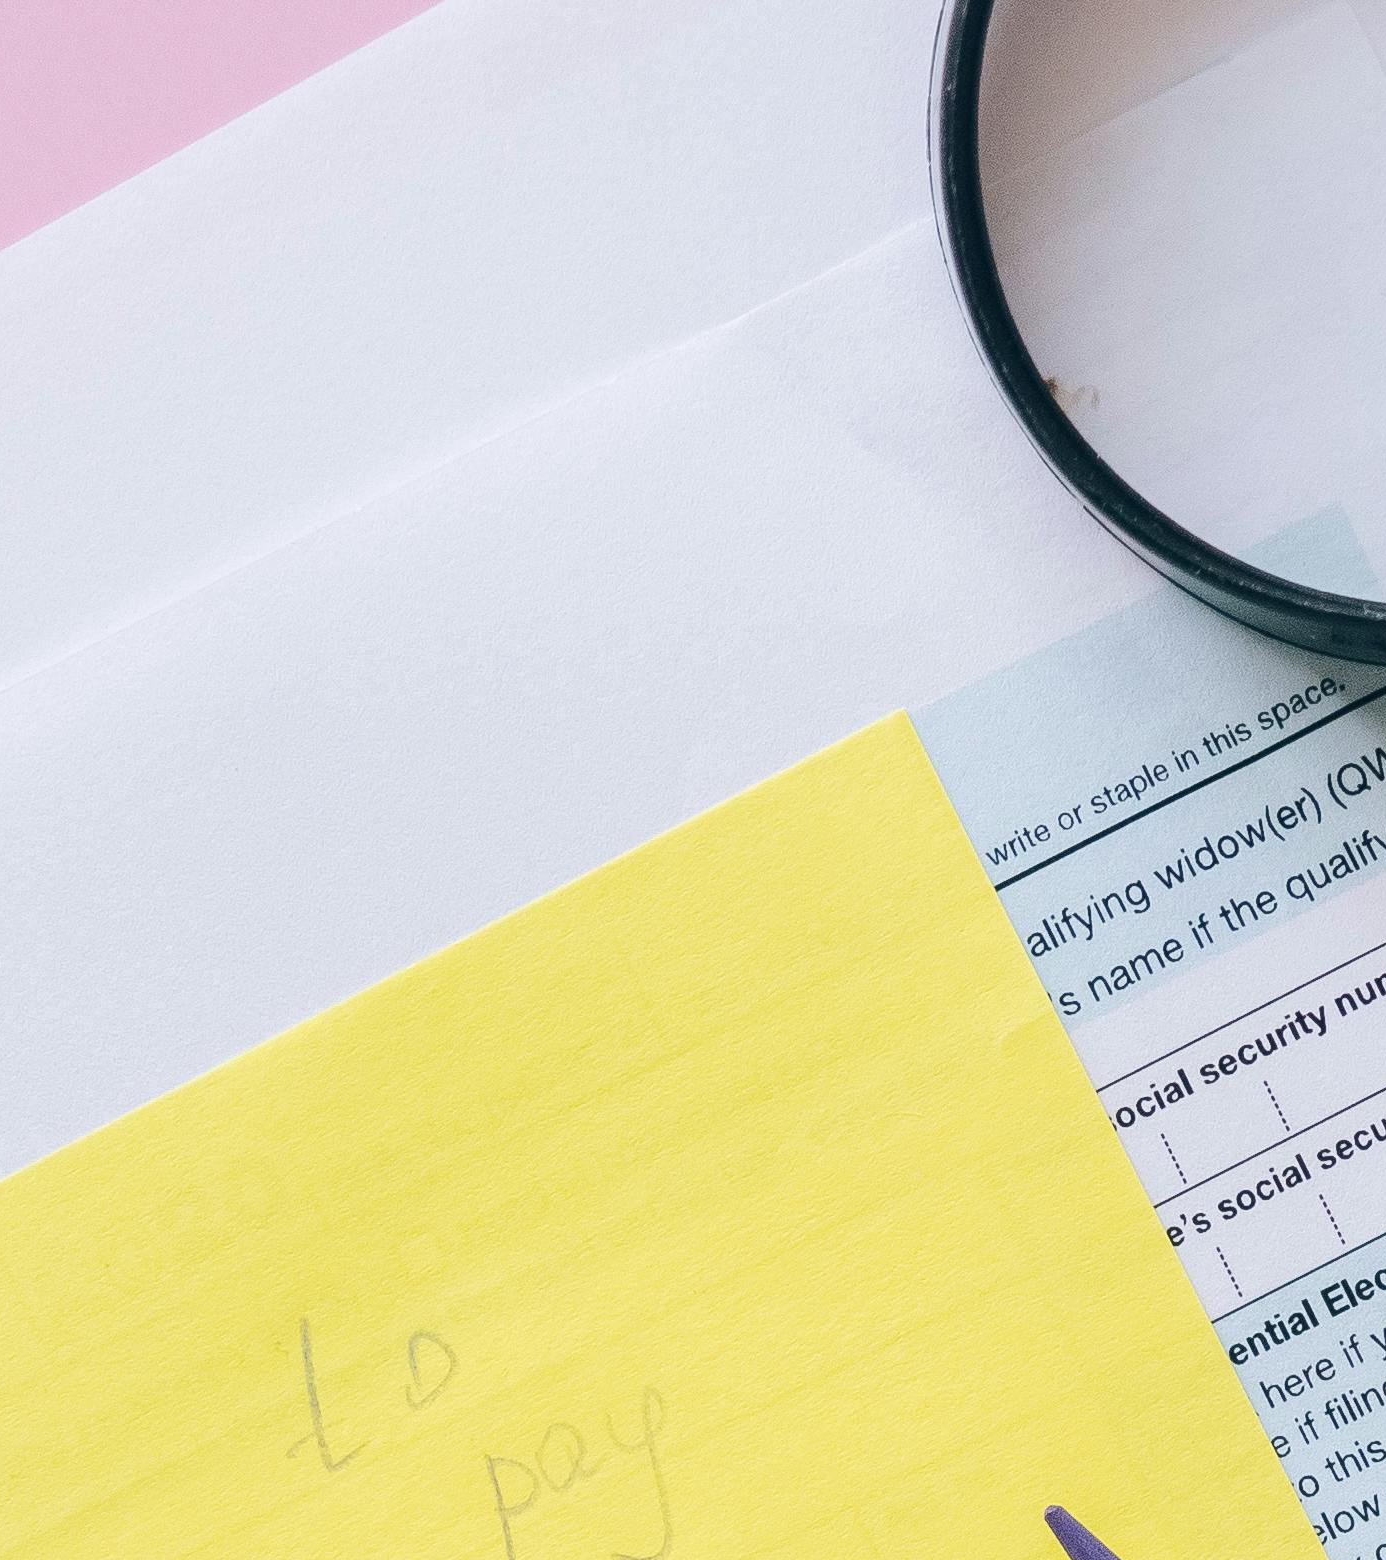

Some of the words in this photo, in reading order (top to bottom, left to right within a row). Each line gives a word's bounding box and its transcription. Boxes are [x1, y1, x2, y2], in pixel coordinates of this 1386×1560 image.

[983, 822, 1052, 867] write
[1056, 803, 1084, 832] or
[1089, 762, 1171, 815] staple
[1169, 748, 1201, 774] in
[1201, 721, 1254, 758] this
[1255, 676, 1347, 732] space.
[1151, 786, 1323, 891] widow(er)
[1257, 1356, 1337, 1410] here
[1338, 1332, 1366, 1369] if
